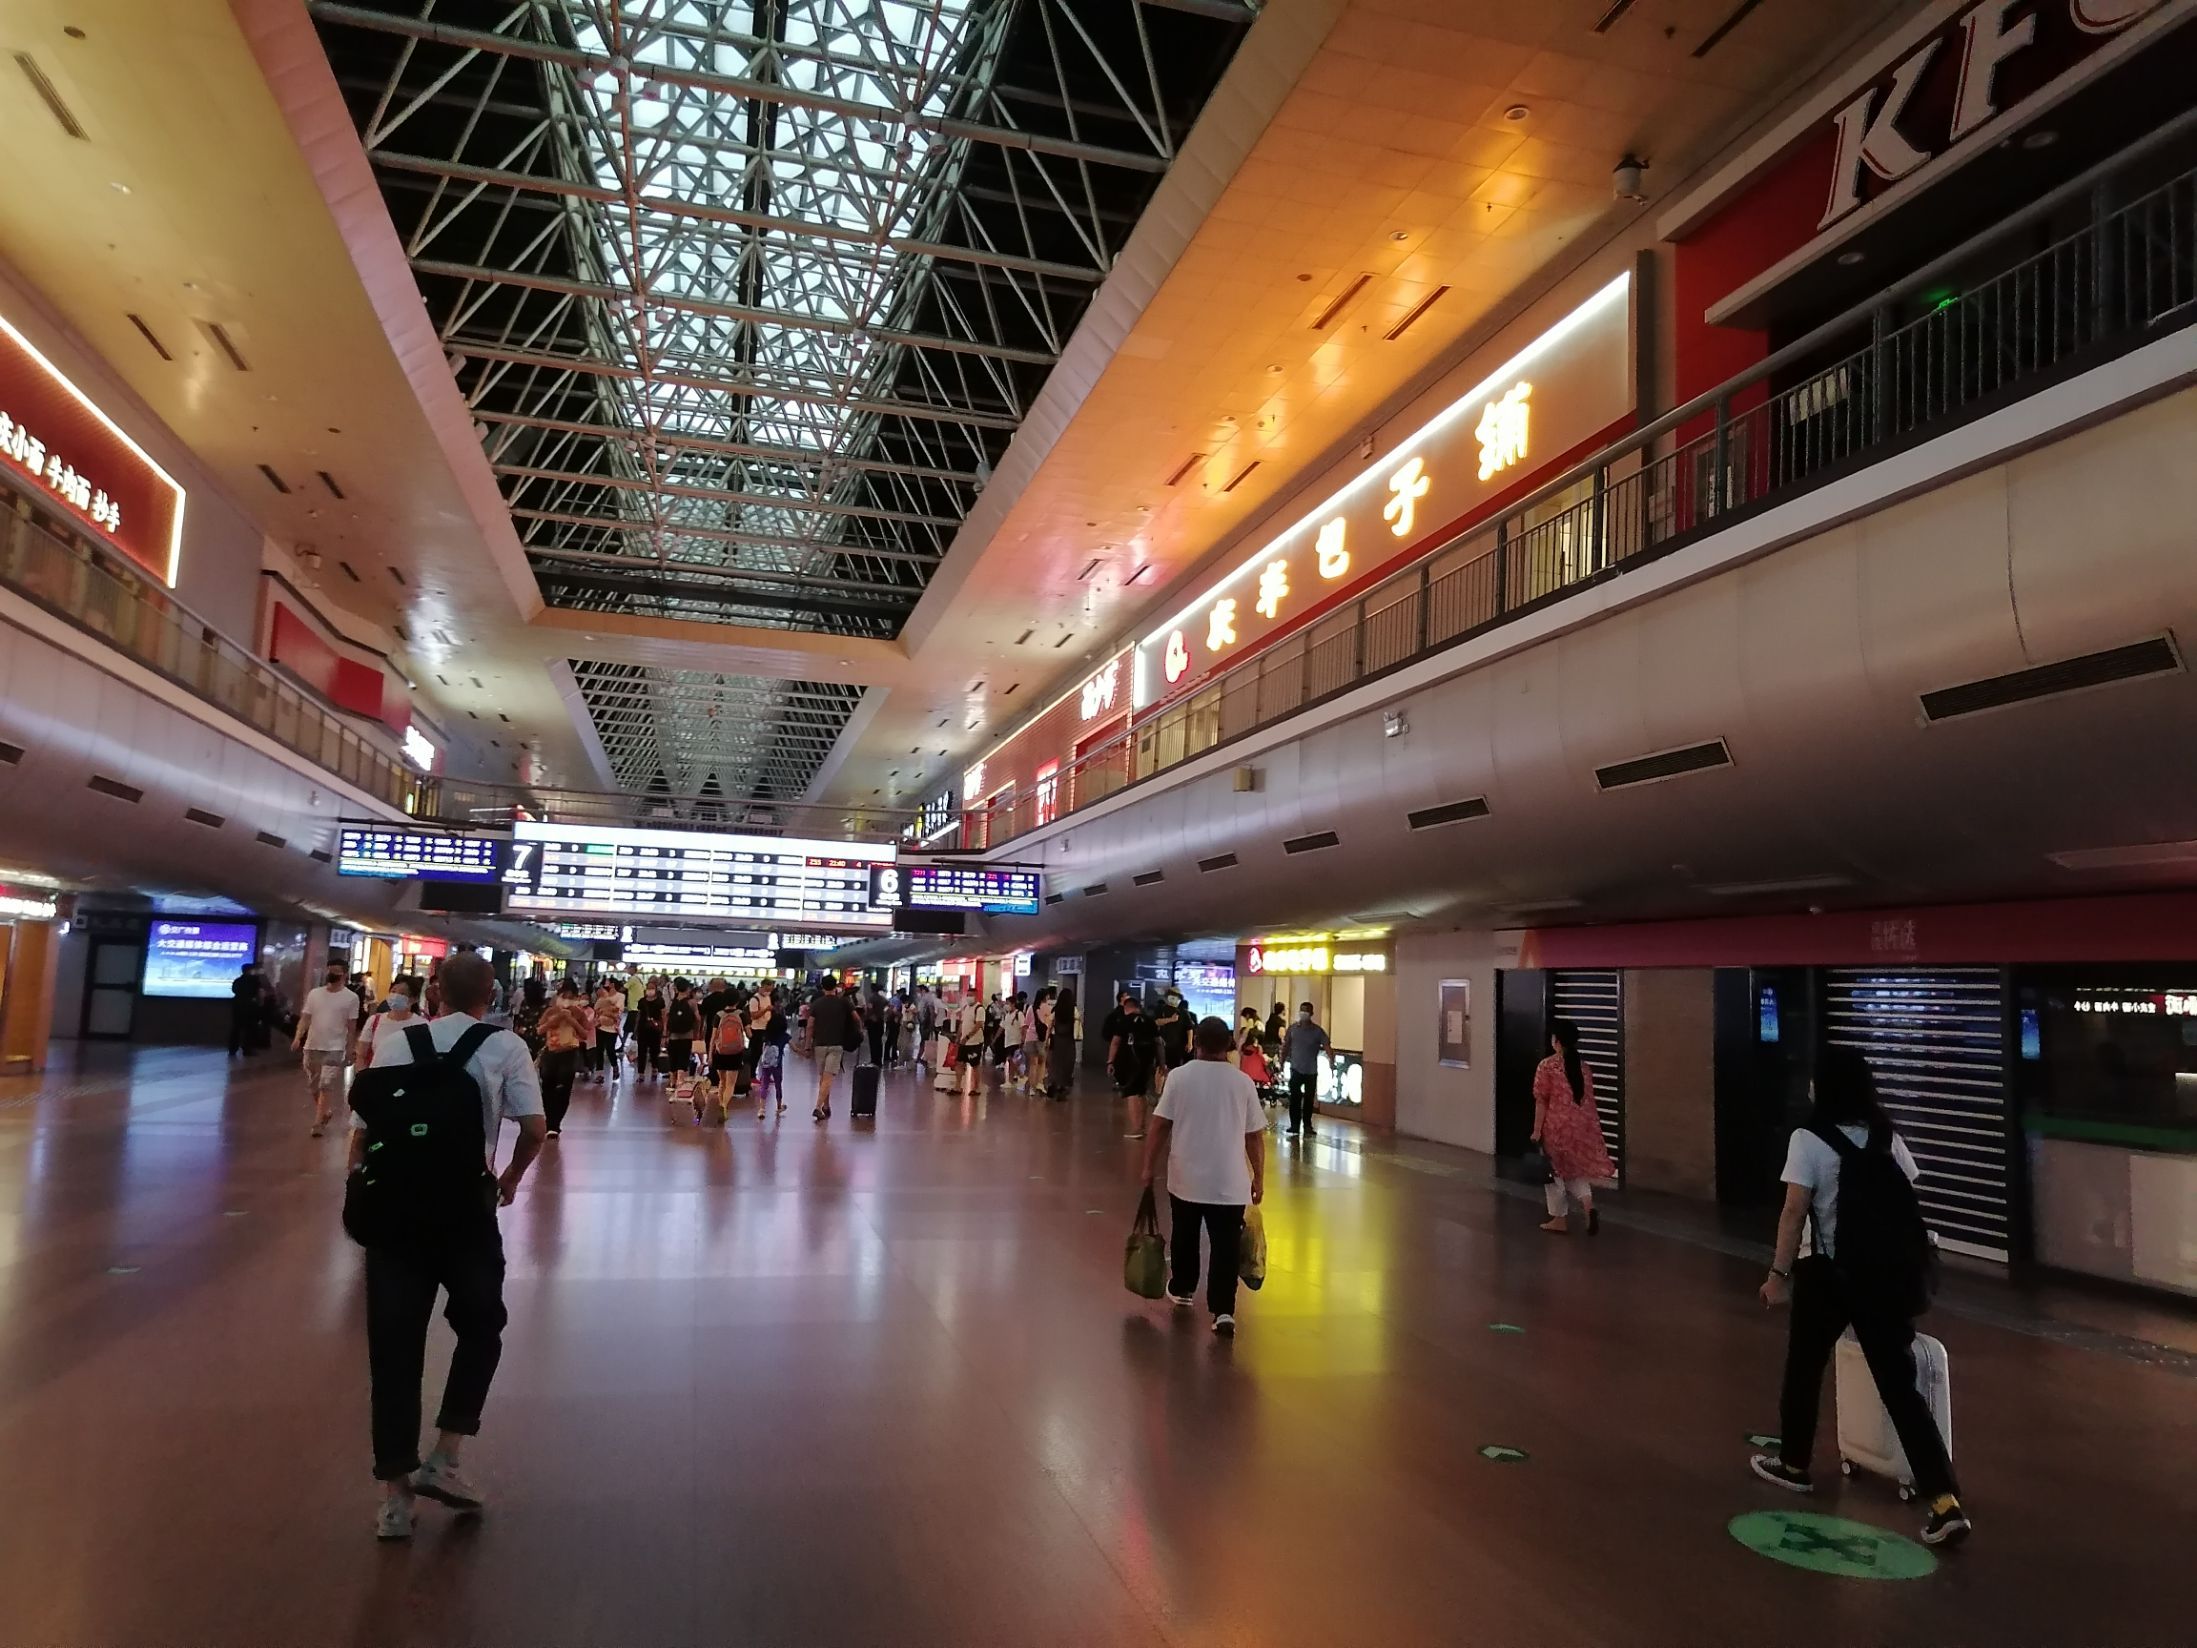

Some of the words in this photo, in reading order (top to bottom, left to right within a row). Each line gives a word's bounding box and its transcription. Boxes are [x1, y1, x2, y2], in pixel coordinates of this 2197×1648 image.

[45, 454, 91, 511] 牛肉面
[91, 488, 120, 533] 抄手
[512, 844, 533, 869] 7
[880, 869, 899, 894] 6
